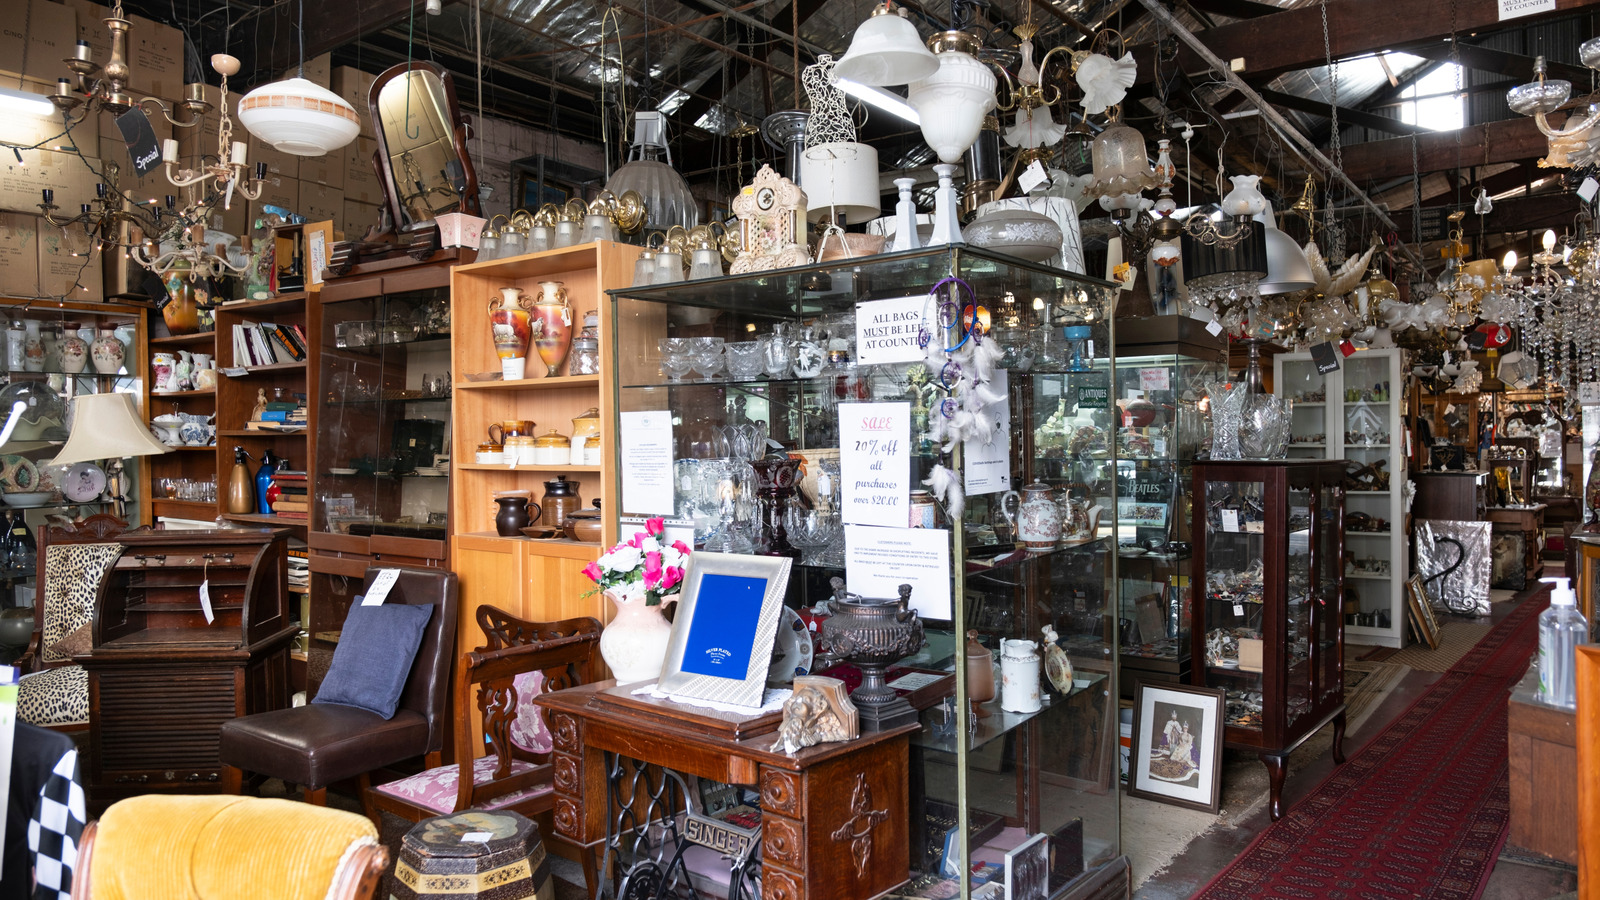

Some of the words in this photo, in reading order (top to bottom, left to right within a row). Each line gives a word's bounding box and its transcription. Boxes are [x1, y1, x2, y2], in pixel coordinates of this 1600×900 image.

[136, 145, 159, 170] Special
[873, 313, 891, 324] ALL
[893, 311, 919, 322] BAGS
[863, 327, 889, 337] MUST
[891, 325, 903, 335] BE
[865, 340, 876, 350] AT
[1318, 361, 1337, 373] Special
[1085, 389, 1107, 400] ANTIQUES
[861, 416, 893, 430] SALE
[881, 440, 898, 456] off
[870, 460, 882, 470] all
[855, 478, 897, 490] purchases
[1128, 480, 1160, 495] BEATLES
[872, 495, 898, 506] $20.00
[688, 820, 748, 854] SINGER
